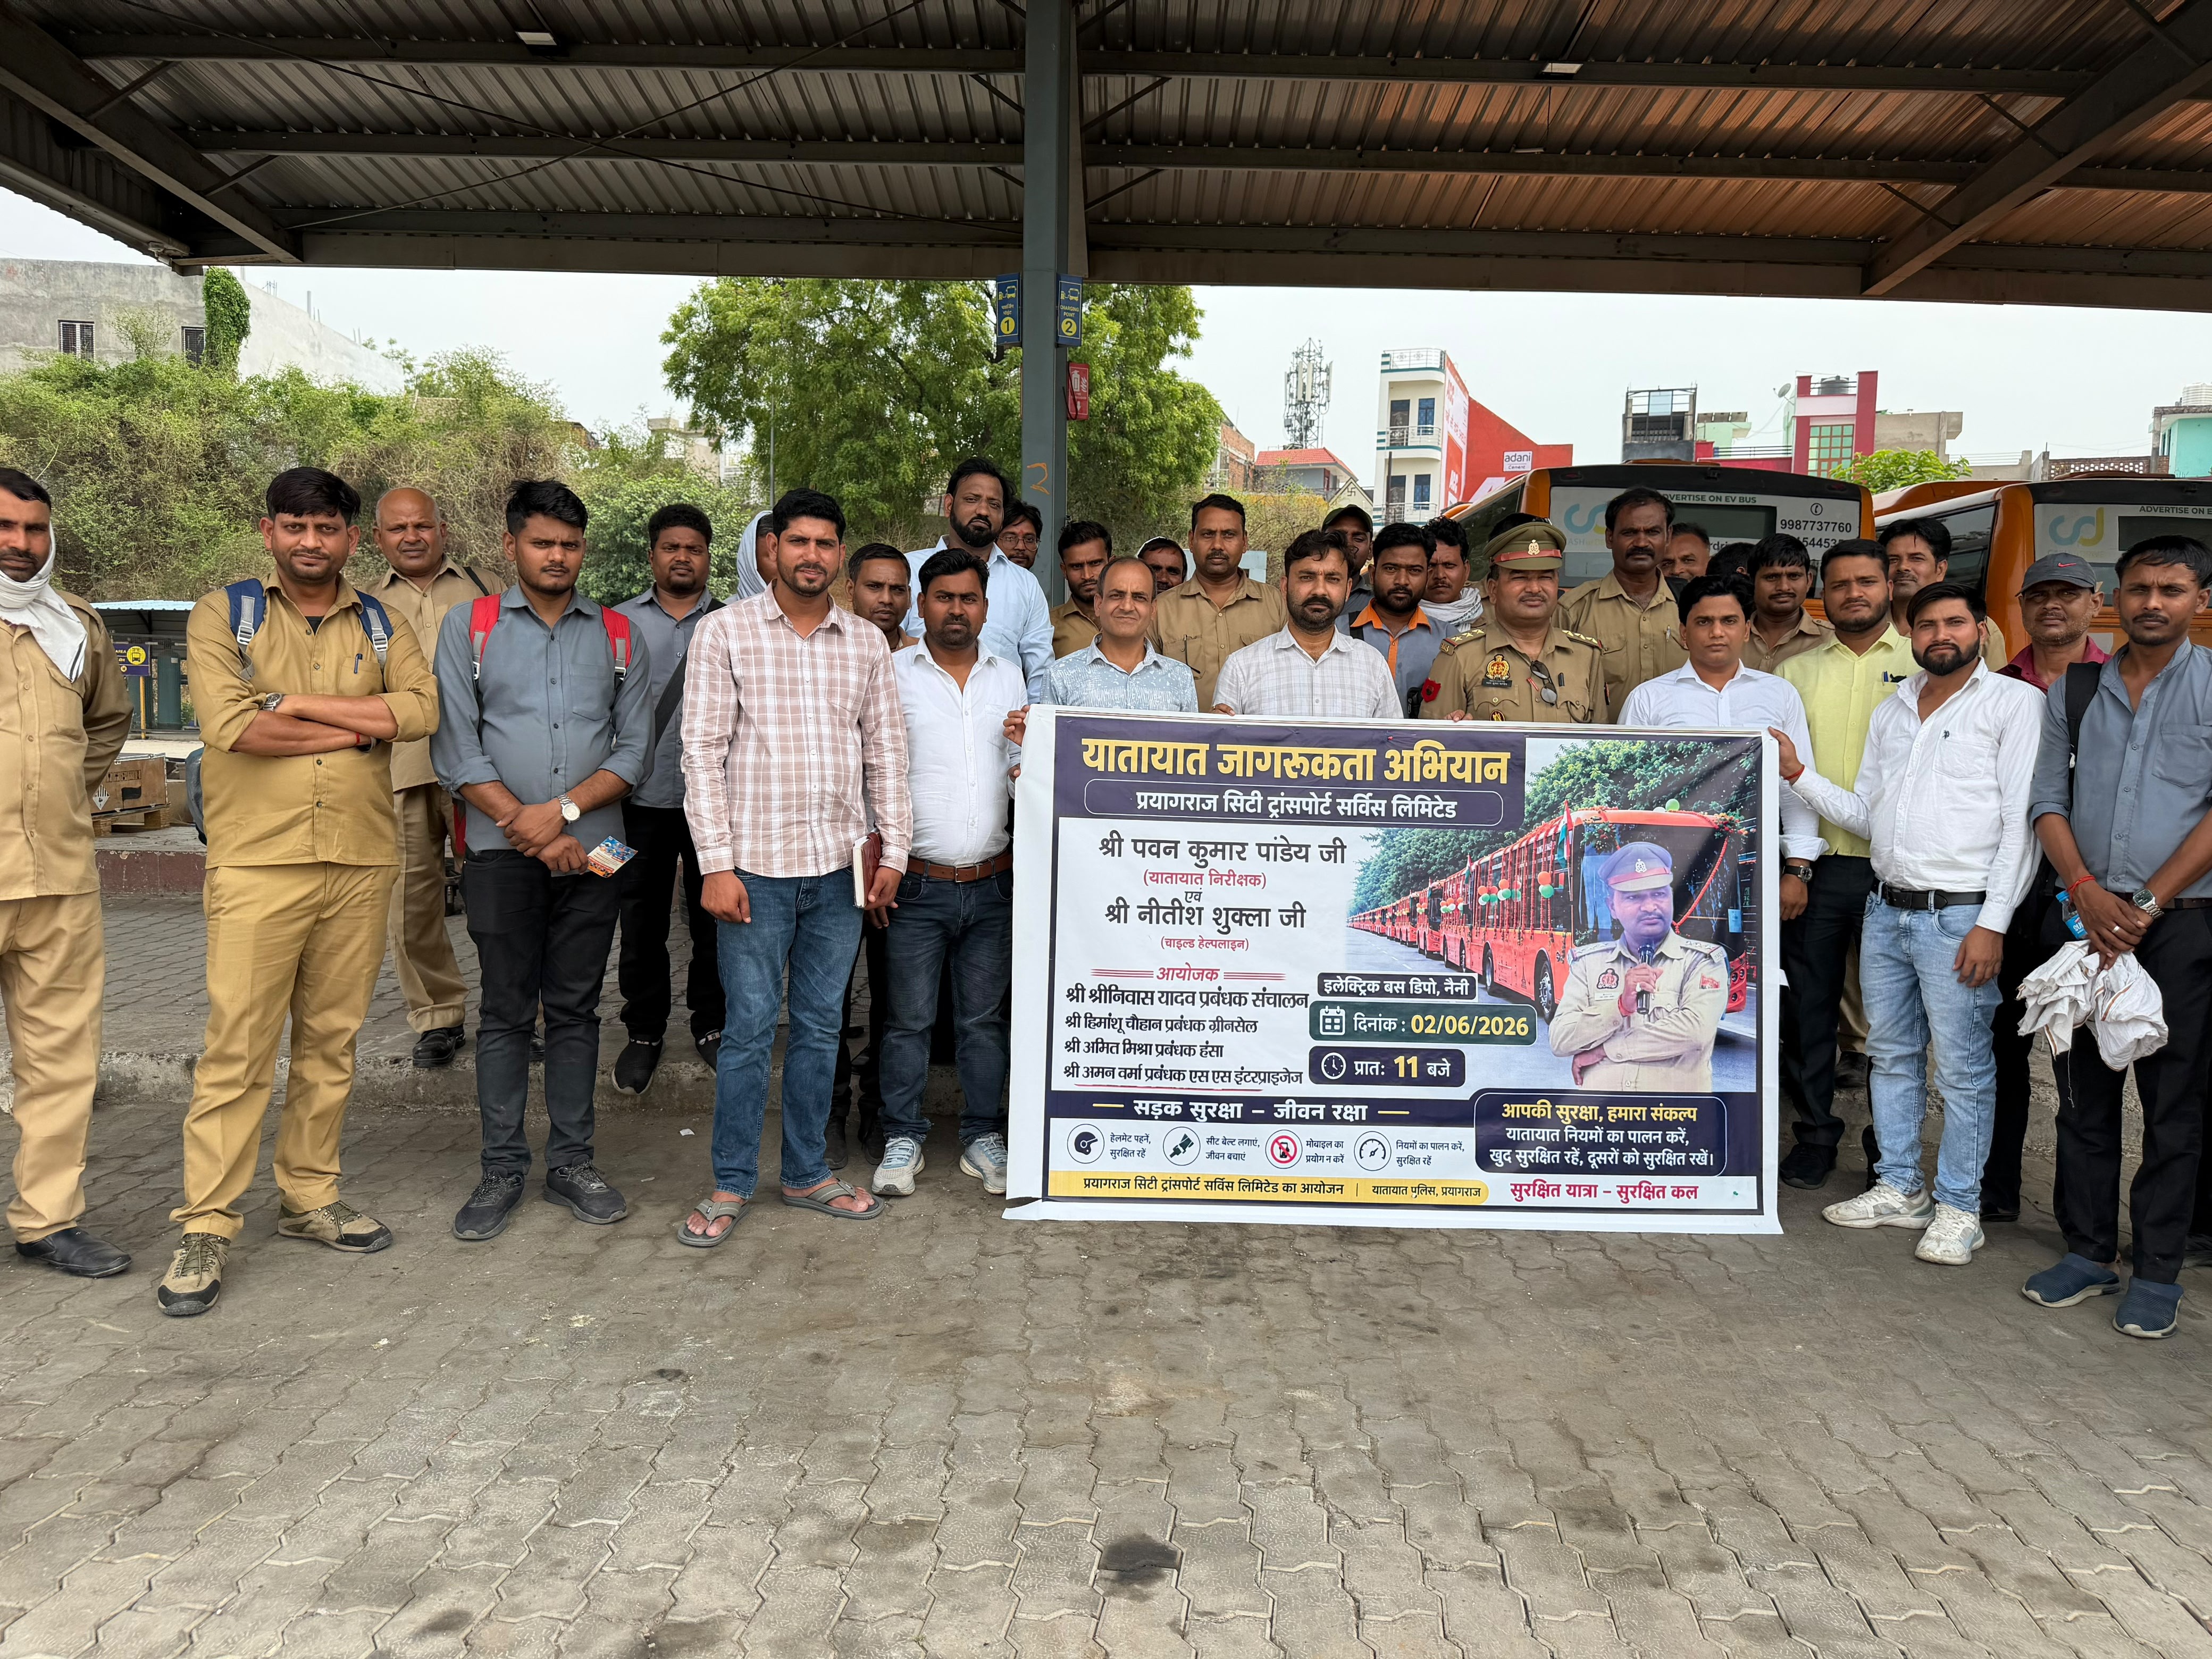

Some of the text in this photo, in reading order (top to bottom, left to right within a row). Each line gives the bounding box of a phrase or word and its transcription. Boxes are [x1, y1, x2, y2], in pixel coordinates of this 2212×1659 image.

[1004, 319, 1009, 331] 1
[1065, 321, 1073, 333] 2
[1504, 453, 1531, 463] adani
[1027, 462, 1050, 495] 2
[1780, 519, 1851, 533] 9987737760
[1082, 739, 1511, 784] यातायात जागरूकता अभियान
[1136, 789, 1457, 818] प्रयागराज सिटी ट्रांसपोर्ट सर्विस लिमिटेड
[1098, 830, 1347, 868] श्री पवन कुमार पांडेय जी
[1143, 868, 1267, 890] (यातायात निरीक्षक)
[1184, 887, 1203, 903] एवं
[1104, 896, 1306, 935] श्री नीतीश शुक्ला जी
[1161, 936, 1249, 951] (चाइल्ड हेल्पलाइन)
[1156, 962, 1220, 982] आयोजक
[1066, 983, 1309, 1009] श्री श्रीनिवास यादव प्रबंधक संचालन
[1323, 976, 1470, 997] इलेक्ट्रिक बस डिपो, नैनी
[1065, 1011, 1082, 1028] श्री
[1125, 1014, 1162, 1032] चौहान
[1165, 1015, 1206, 1033] प्रबंधक
[1209, 1017, 1258, 1034] ग्रीनसेल
[1411, 1015, 1529, 1036] 02/06/2026
[1064, 1036, 1224, 1059] श्री अमित मिश्रा प्रबंधक हंसा
[1063, 1061, 1303, 1086] श्री अमन वर्मा प्रबंधक एस एस इंटरप्राइजेज
[1394, 1055, 1418, 1078] 11
[1427, 1058, 1451, 1077] बजे
[1133, 1100, 1183, 1120] सड़क
[1189, 1101, 1243, 1122] सुरक्षा
[1273, 1099, 1326, 1120] जीवन
[1331, 1104, 1368, 1122] रक्षा
[1502, 1099, 1698, 1125] आपकी सुरक्षा, हमारा संकल्प
[1110, 1132, 1151, 1144] हेलमेट पहनें,
[1205, 1136, 1260, 1149] सीट बेल्ट लगाएं,
[1334, 1140, 1344, 1149] का
[1396, 1140, 1464, 1152] नियमों का पालन करें,
[1505, 1126, 1689, 1146] यातायात नियमों का पालन करें,
[1110, 1147, 1146, 1160] सुरक्षित रहें
[1205, 1151, 1246, 1161] जीवन बचाएं
[1305, 1152, 1345, 1164] प्रयोग न करें
[1396, 1155, 1432, 1167] सुरक्षित रहें
[1489, 1146, 1714, 1170] खुद सुरक्षित रहें, दूसरों को सुरक्षित रखें।
[1084, 1175, 1344, 1195] प्रयागराज सिटी ट्रांसपोर्ट सर्विस लिमिटेड का आयोजन
[1372, 1183, 1481, 1199] यातायात पुलिस, प्रयागराज
[1510, 1179, 1561, 1203] सुरक्षित
[1565, 1183, 1598, 1199] यात्रा
[1616, 1180, 1667, 1203] सुरक्षित
[1671, 1185, 1699, 1200] कल
